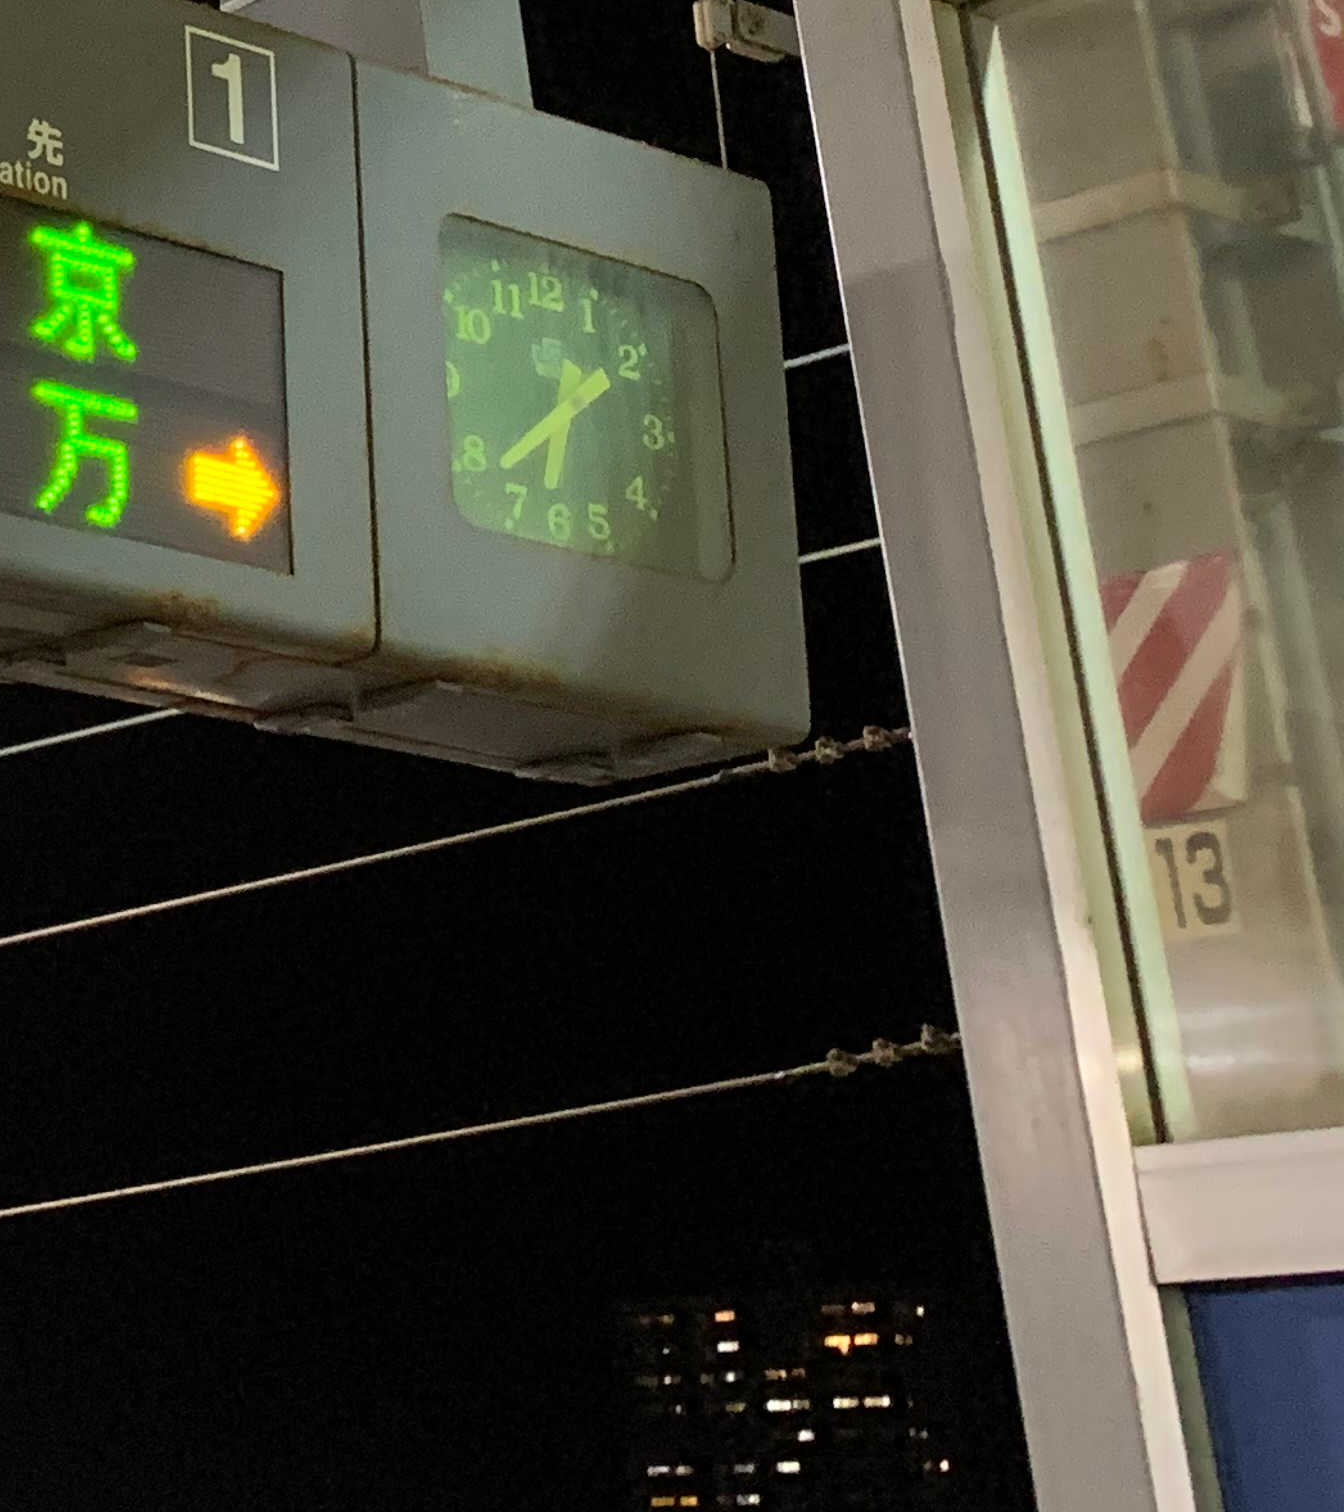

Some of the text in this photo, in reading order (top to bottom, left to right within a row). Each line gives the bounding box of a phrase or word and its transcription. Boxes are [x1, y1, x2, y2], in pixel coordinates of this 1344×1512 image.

[212, 53, 245, 145] 1
[491, 279, 523, 319] 11
[528, 271, 564, 312] 12
[456, 306, 491, 344] 10
[581, 298, 596, 333] 1
[619, 344, 641, 380] 2
[643, 414, 665, 450] 3
[463, 435, 487, 473] 8
[506, 483, 527, 520] 7
[625, 476, 647, 511] 4
[548, 503, 571, 541] 6
[587, 503, 611, 540] 5
[1155, 832, 1232, 928] 13
